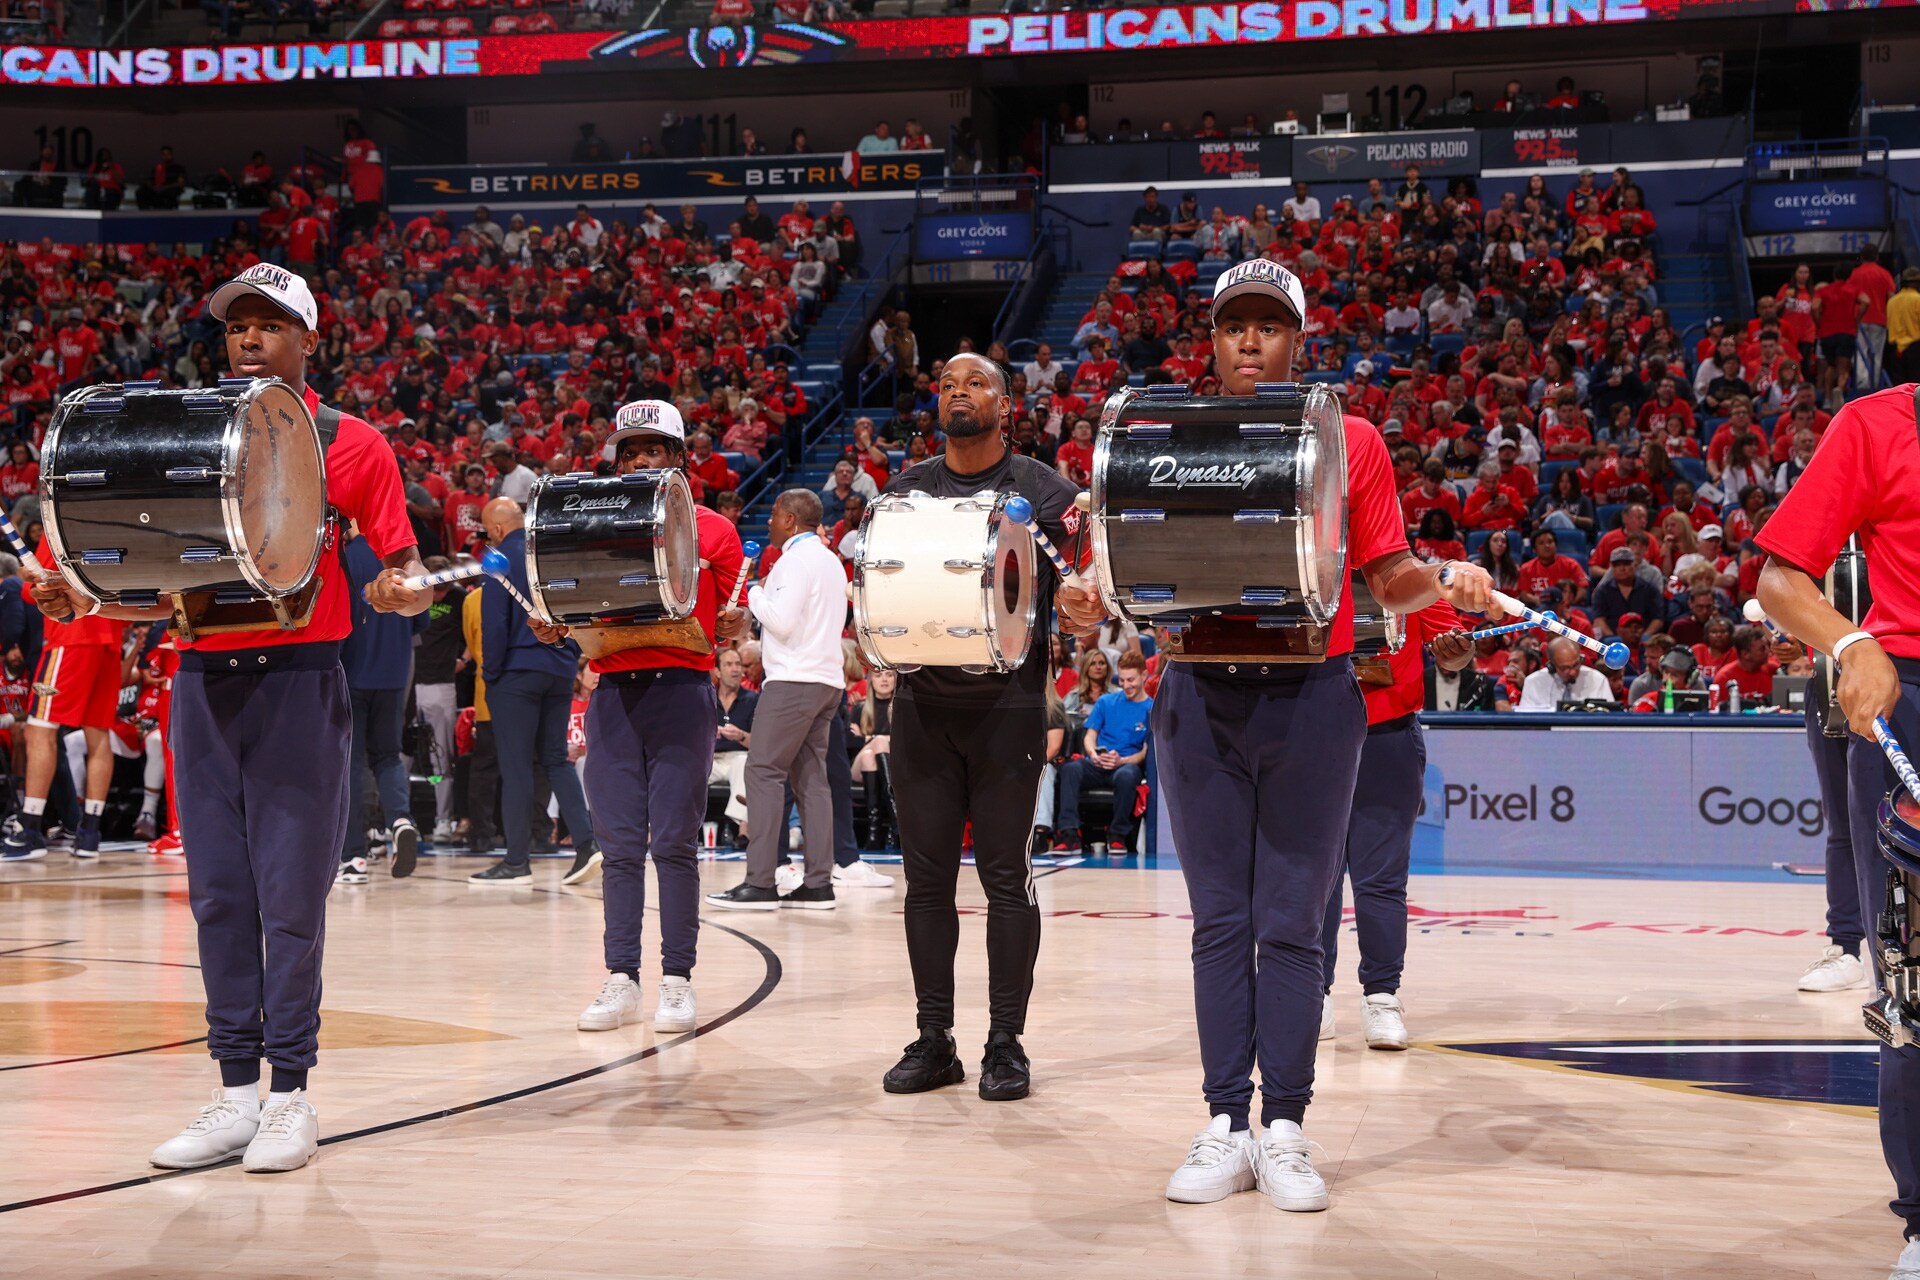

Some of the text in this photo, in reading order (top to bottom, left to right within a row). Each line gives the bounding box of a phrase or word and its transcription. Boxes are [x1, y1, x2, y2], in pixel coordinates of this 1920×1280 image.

[967, 0, 1648, 54] PELICANS DRUMLINE
[182, 39, 480, 82] DRUMLINE
[1867, 45, 1891, 63] 113
[1094, 86, 1114, 102] 112
[1365, 84, 1428, 129] 112
[1514, 127, 1579, 141] NEWS TALK
[34, 125, 93, 169] 110
[1199, 141, 1260, 154] NEWS TALK
[1367, 140, 1469, 161] PELICANS RADIO
[470, 172, 640, 193] BETRIVERS
[1774, 193, 1857, 208] GREY GOOSE
[938, 226, 1008, 239] GREY GOOSE
[1763, 234, 1796, 256] 112
[928, 264, 951, 282] 111
[1227, 263, 1292, 293] PELICANS
[279, 408, 294, 427] EVANS
[619, 407, 660, 427] PELICANS
[1149, 455, 1257, 490] Dynasty
[563, 494, 631, 512] Dynasty
[1444, 784, 1537, 823] Pixel
[1550, 785, 1575, 823] 8
[1699, 786, 1824, 837] Goog
